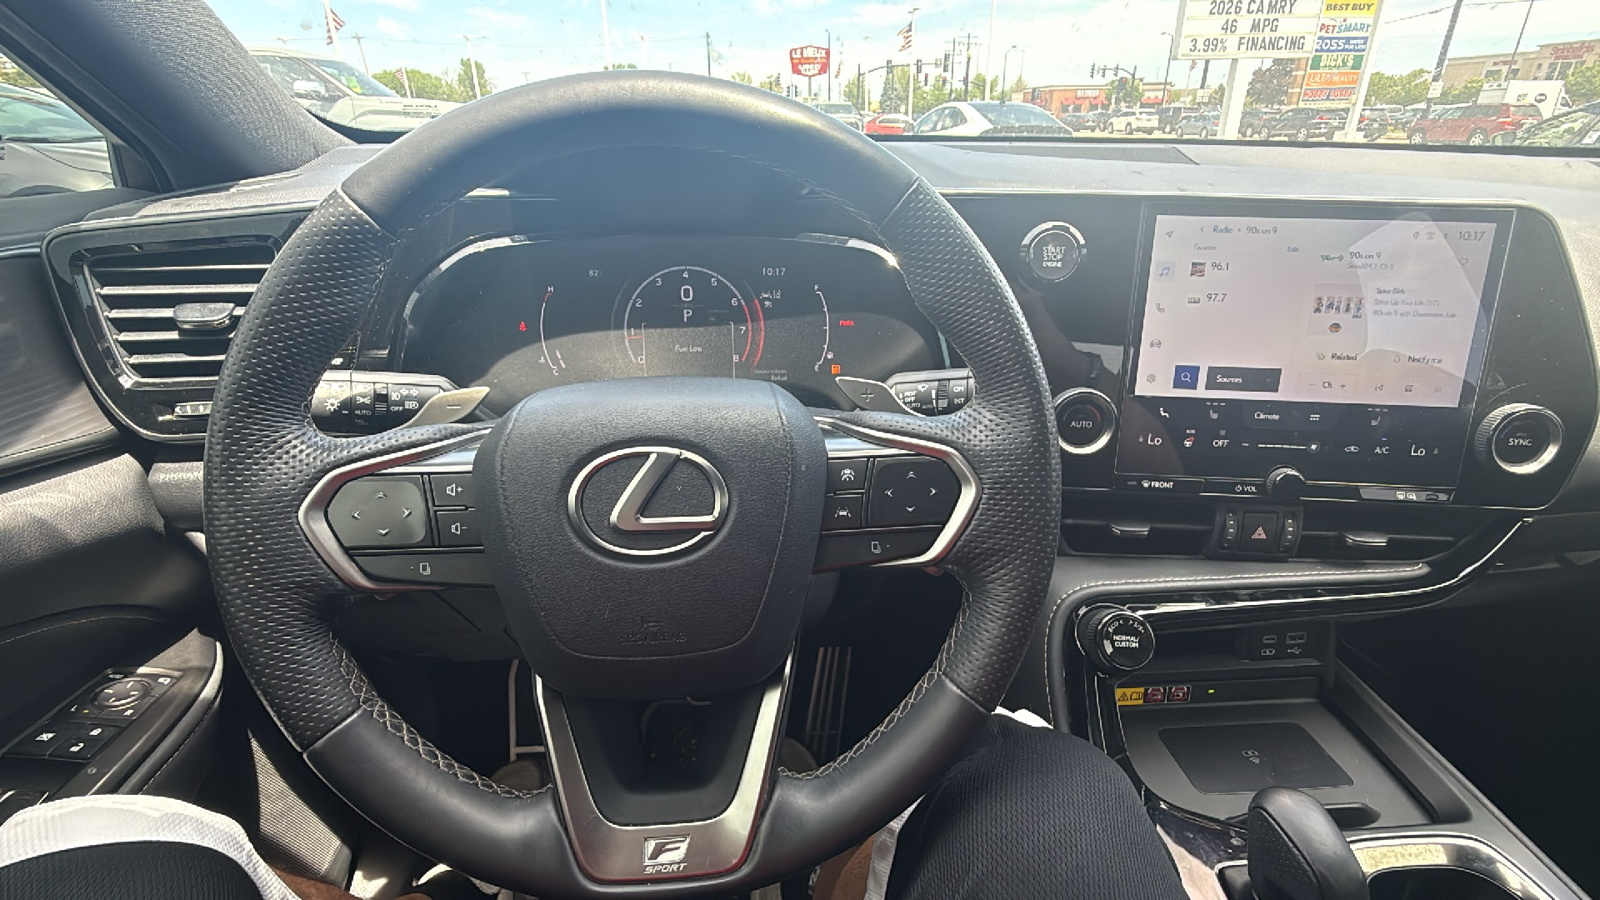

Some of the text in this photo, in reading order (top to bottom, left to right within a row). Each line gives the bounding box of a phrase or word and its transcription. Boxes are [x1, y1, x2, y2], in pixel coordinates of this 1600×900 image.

[1209, 0, 1297, 15] 2026 CAMRY
[1326, 3, 1374, 11] BEST BUY
[1221, 18, 1279, 33] 46 MPG
[1319, 23, 1371, 34] PETSMART
[1189, 36, 1306, 53] 3.99% FINANCING
[1315, 39, 1345, 50] ROSS
[1320, 54, 1354, 67] DICK'S
[1303, 88, 1354, 99] HOBBY LOBBY
[1212, 225, 1233, 234] Radio
[1246, 226, 1260, 234] 90s
[1272, 226, 1277, 234] 9
[1458, 231, 1485, 241] 10:17
[1042, 246, 1066, 254] START
[1211, 262, 1229, 271] 96.1
[762, 268, 786, 276] 10:17
[656, 278, 662, 286] 3
[711, 278, 717, 286] 5
[1206, 293, 1227, 302] 97.7
[635, 299, 642, 307] 2
[731, 298, 738, 306] 6
[683, 309, 693, 322] P
[739, 326, 746, 334] 7
[733, 354, 739, 362] 8
[1331, 353, 1358, 361] Related
[1408, 355, 1429, 365] Notify
[1216, 375, 1242, 383] Sources
[1322, 381, 1332, 389] Ch
[1254, 411, 1280, 420] Climate
[1070, 421, 1093, 429] AUTO
[1147, 433, 1162, 446] Lo
[1212, 439, 1230, 447] OFF
[1508, 438, 1533, 446] SYNC
[1374, 446, 1390, 454] A/C
[1410, 444, 1426, 456] Lo
[1151, 481, 1174, 489] FRONT
[1244, 485, 1257, 493] VOL
[1107, 621, 1119, 633] ECO
[643, 863, 688, 874] SPORT
